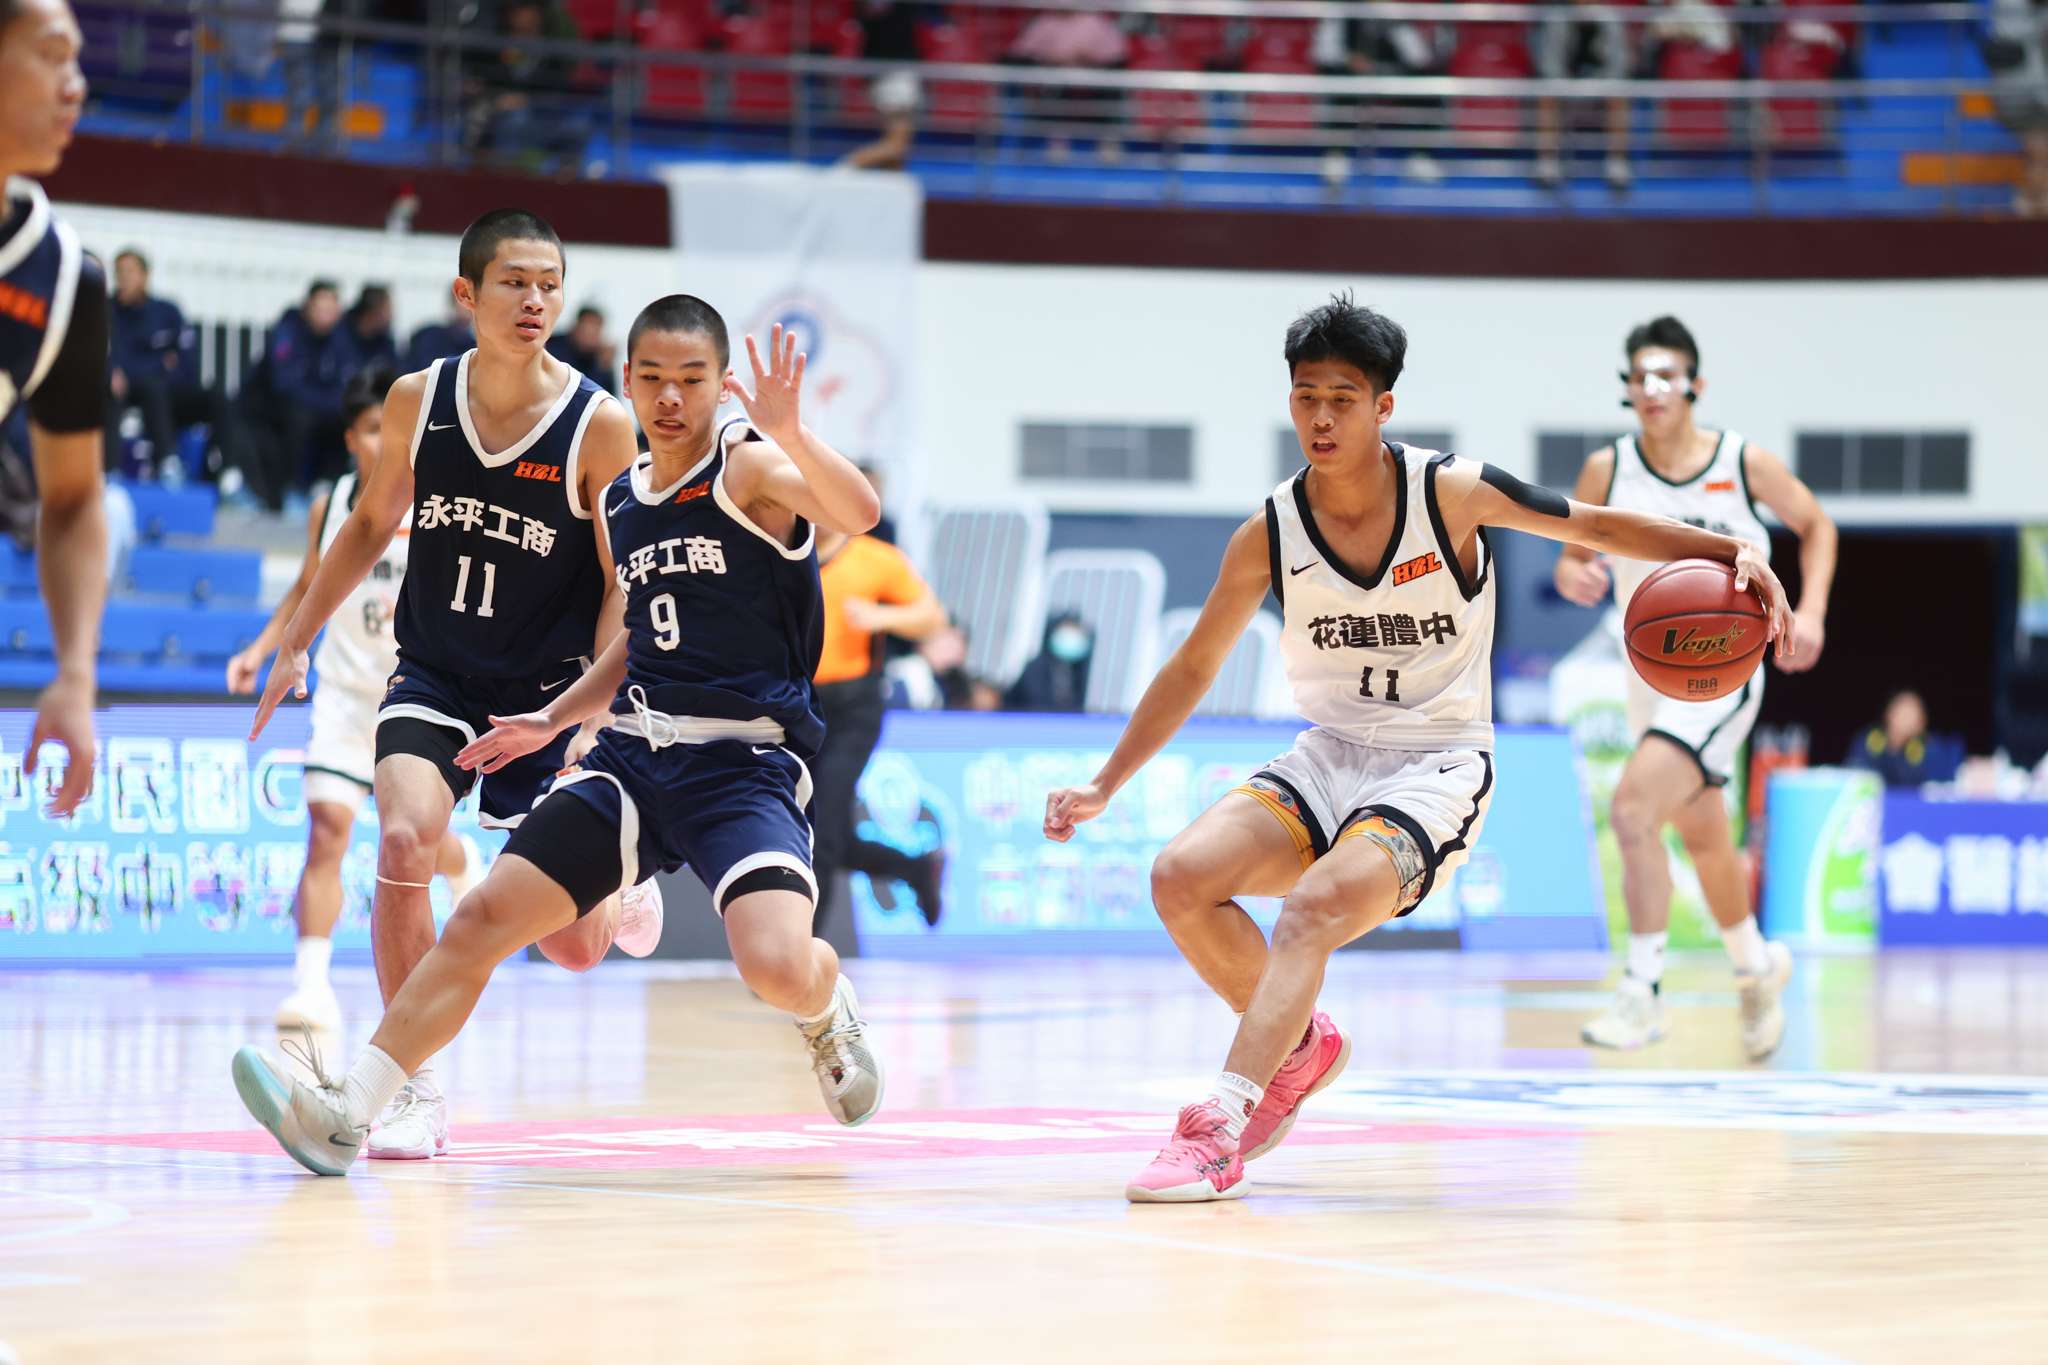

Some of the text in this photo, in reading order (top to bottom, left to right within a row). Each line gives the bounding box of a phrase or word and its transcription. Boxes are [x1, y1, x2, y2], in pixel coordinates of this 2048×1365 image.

[418, 495, 557, 557] 永平工商
[450, 555, 496, 618] 11
[650, 593, 680, 651] 9
[1308, 611, 1457, 650] 花蓮體中
[1661, 626, 1730, 660] Vega
[1359, 666, 1400, 702] 11
[1688, 678, 1718, 689] FIBA
